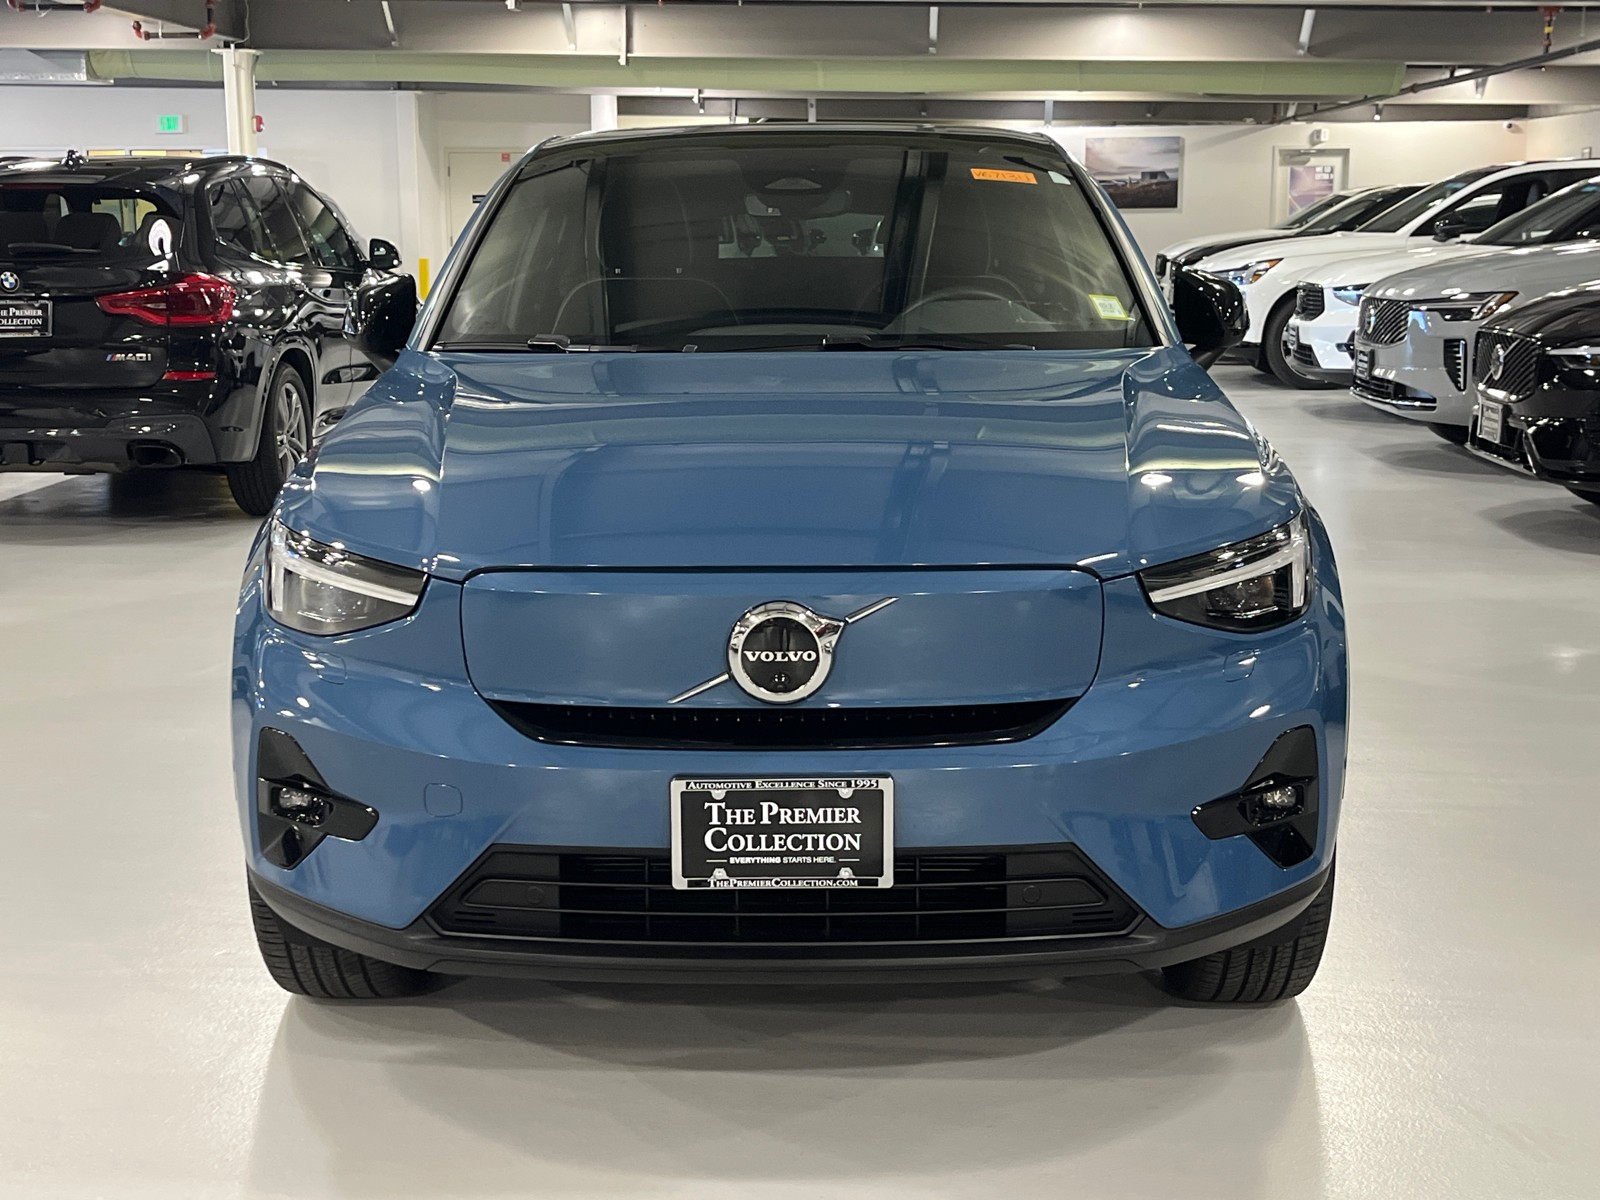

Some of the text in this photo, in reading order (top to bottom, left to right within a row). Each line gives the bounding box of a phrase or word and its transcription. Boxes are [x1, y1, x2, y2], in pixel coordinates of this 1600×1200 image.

[9, 307, 43, 316] PREMIER
[743, 650, 817, 662] VOLVO
[687, 779, 877, 790] AUTOMOTIVE EXCELLENCE SINCE 1995
[704, 801, 862, 825] THE PREMIER
[704, 827, 862, 852] COLLECTION
[729, 856, 781, 864] EVERYTHING
[782, 856, 812, 864] STARTS
